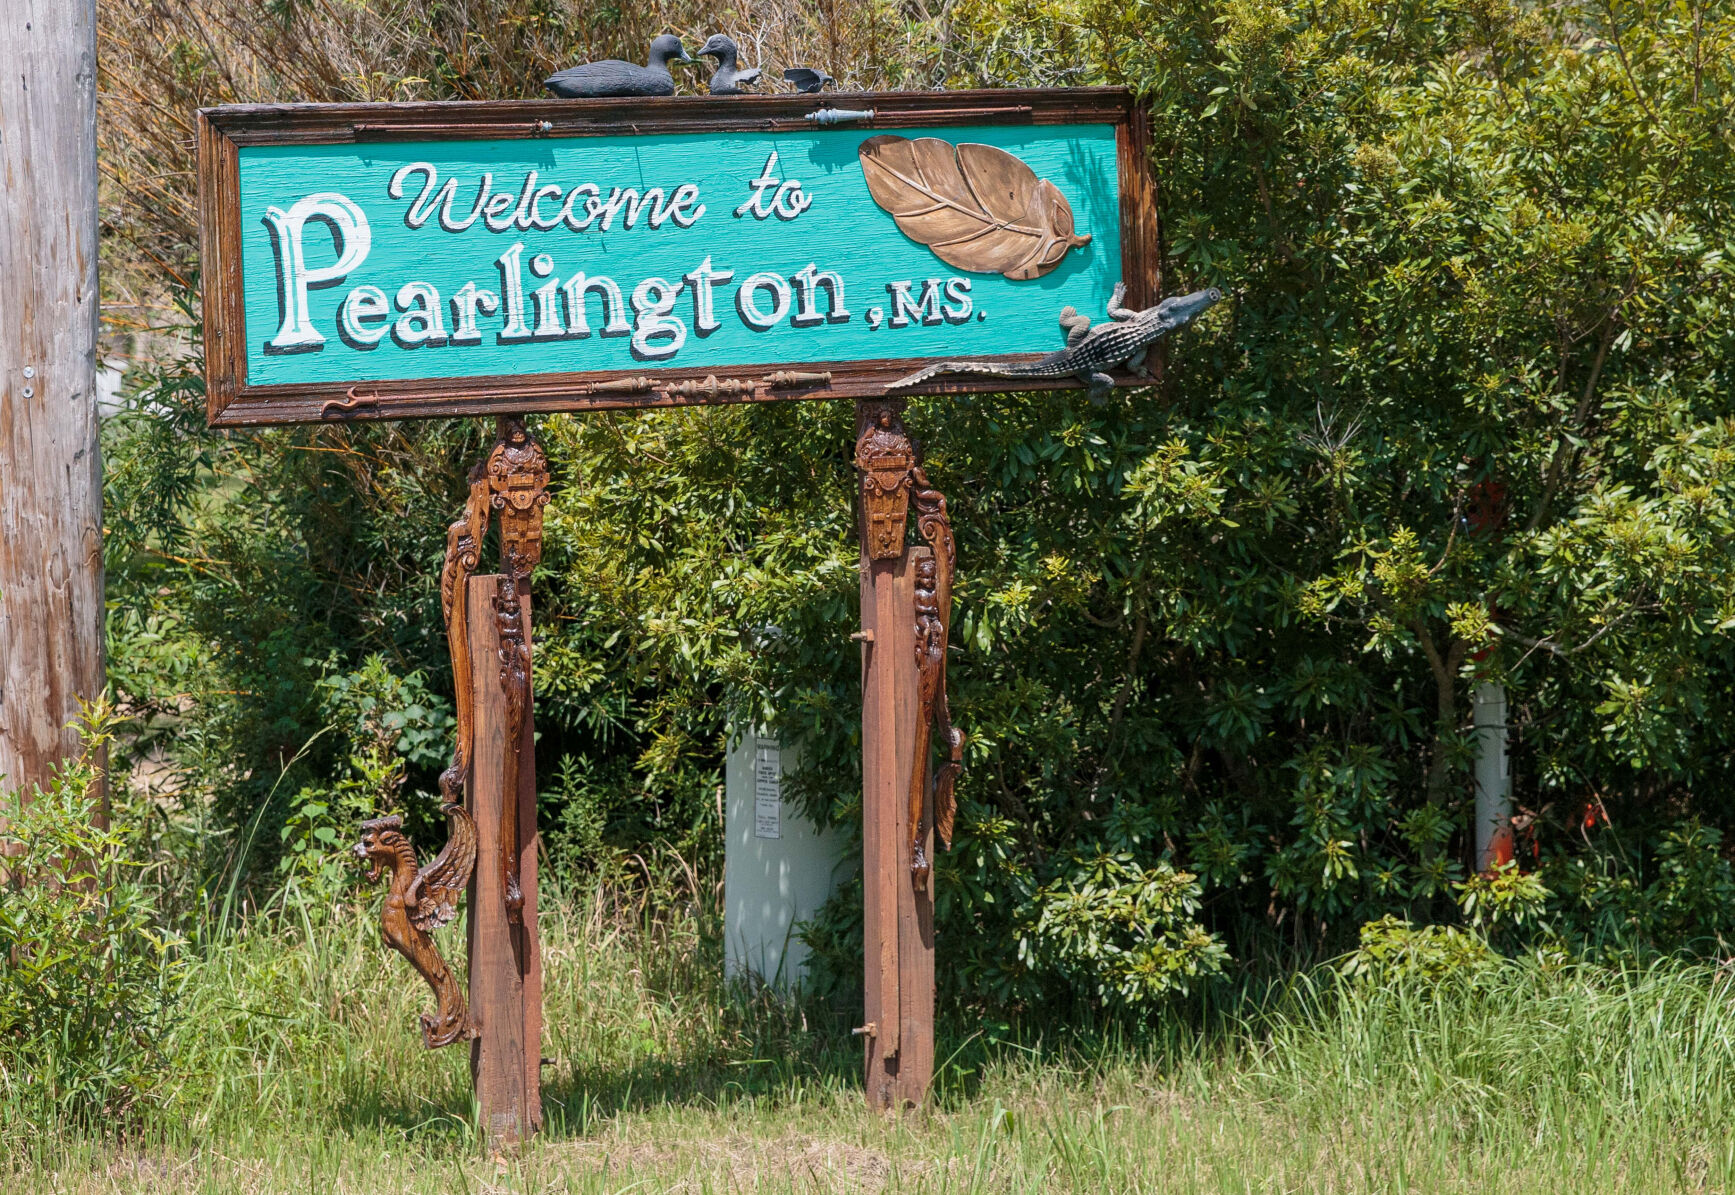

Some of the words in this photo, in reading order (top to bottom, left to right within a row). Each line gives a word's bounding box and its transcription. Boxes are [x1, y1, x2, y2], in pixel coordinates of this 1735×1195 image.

[387, 161, 707, 232] Welcome
[735, 151, 813, 219] to
[262, 192, 851, 360] Pearlington
